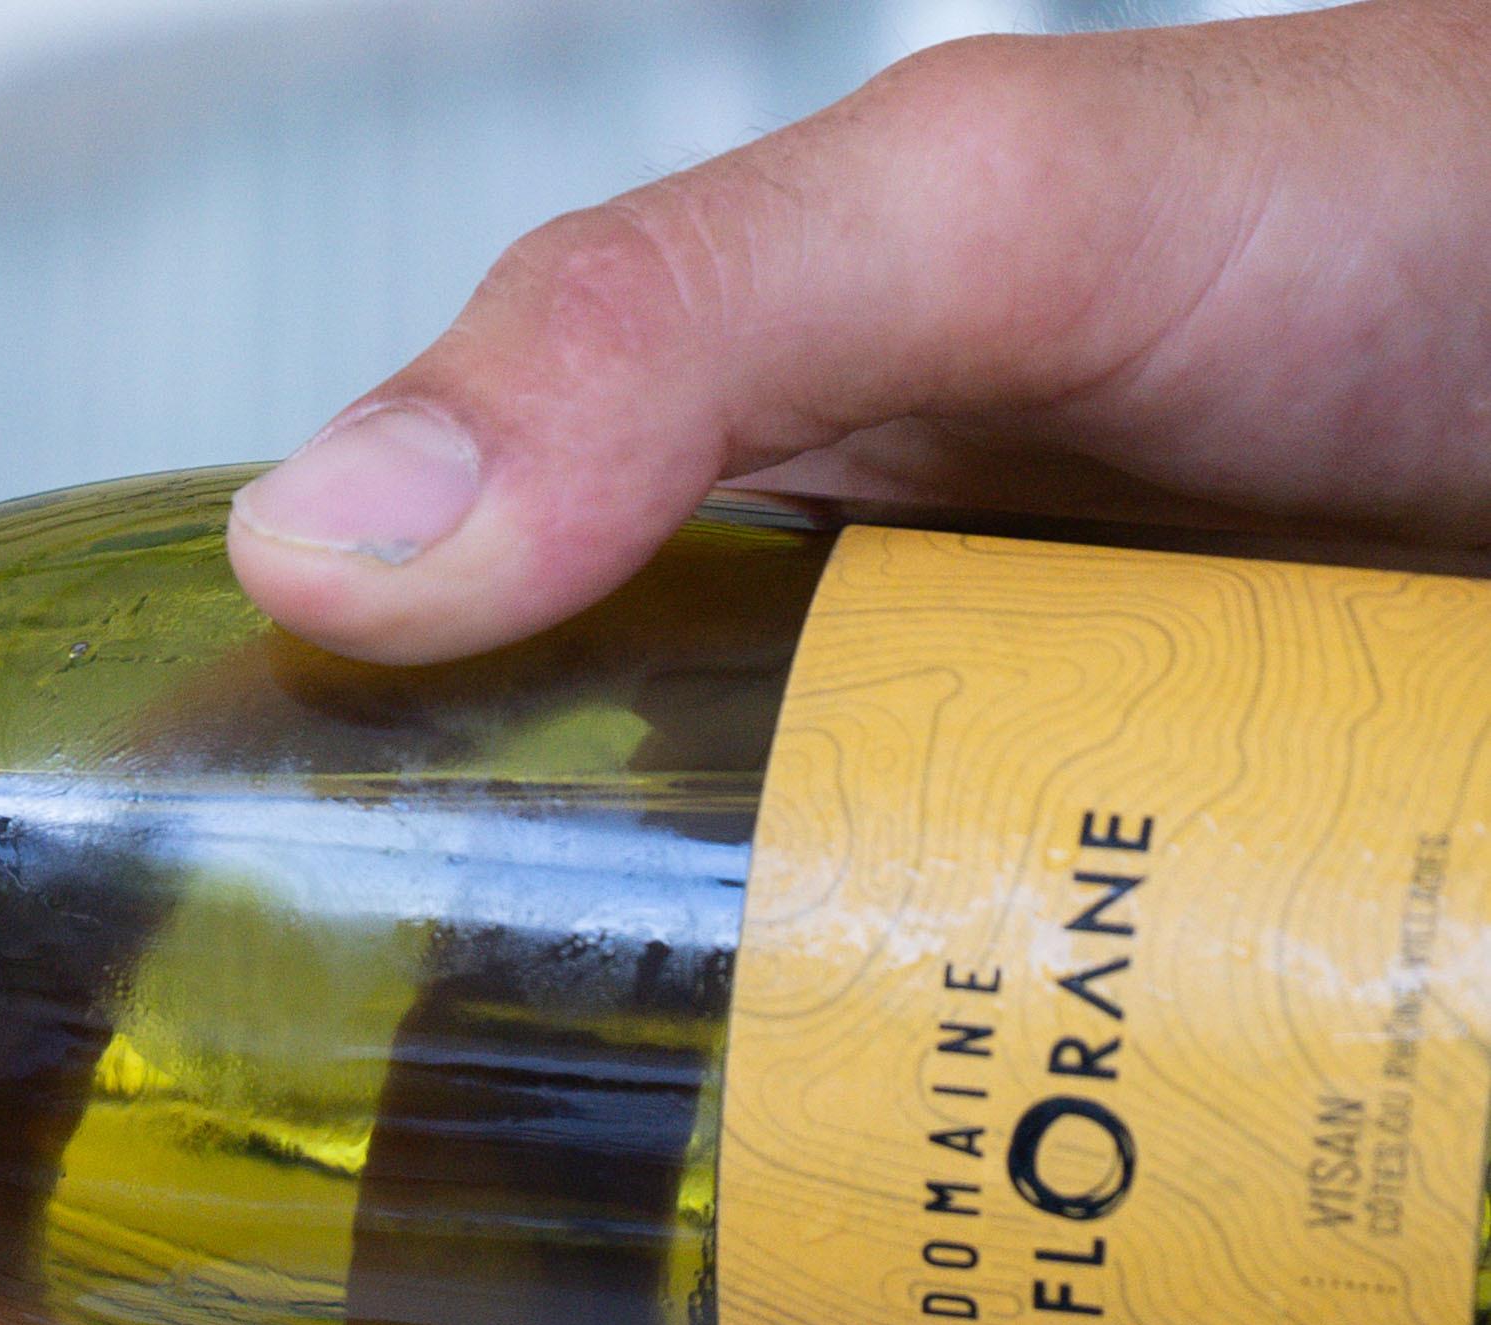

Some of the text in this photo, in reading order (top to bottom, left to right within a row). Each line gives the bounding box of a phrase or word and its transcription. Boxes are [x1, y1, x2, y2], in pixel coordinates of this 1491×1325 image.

[921, 960, 1004, 1321] DOMAINE
[1007, 809, 1155, 1318] FLORANE
[1305, 1095, 1365, 1231] VISAN
